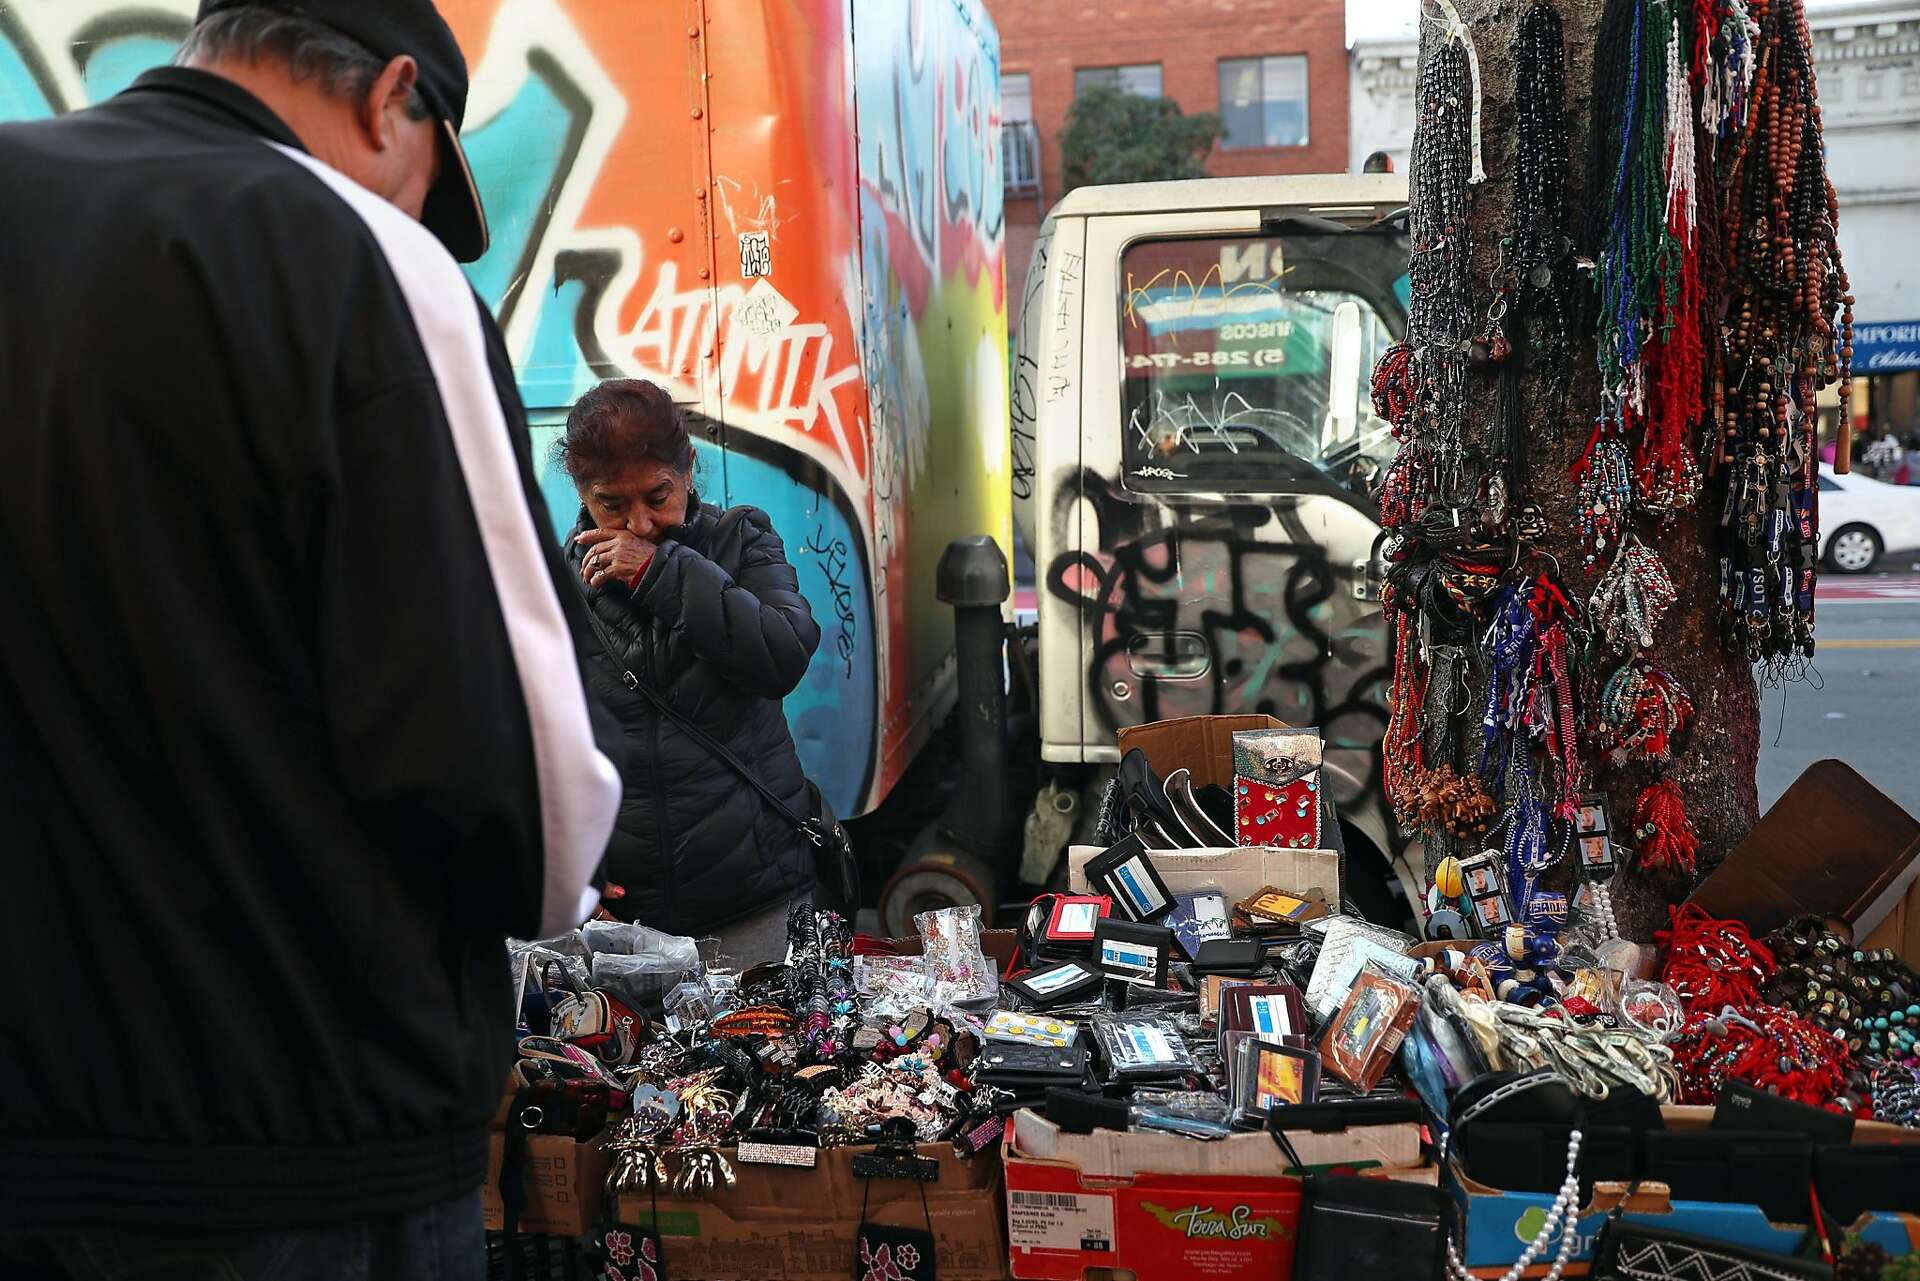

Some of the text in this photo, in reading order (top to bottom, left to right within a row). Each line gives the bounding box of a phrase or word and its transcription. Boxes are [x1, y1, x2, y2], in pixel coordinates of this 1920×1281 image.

[1503, 614, 1536, 657] SALVADO
[1174, 1205, 1266, 1240] Terra Sur
